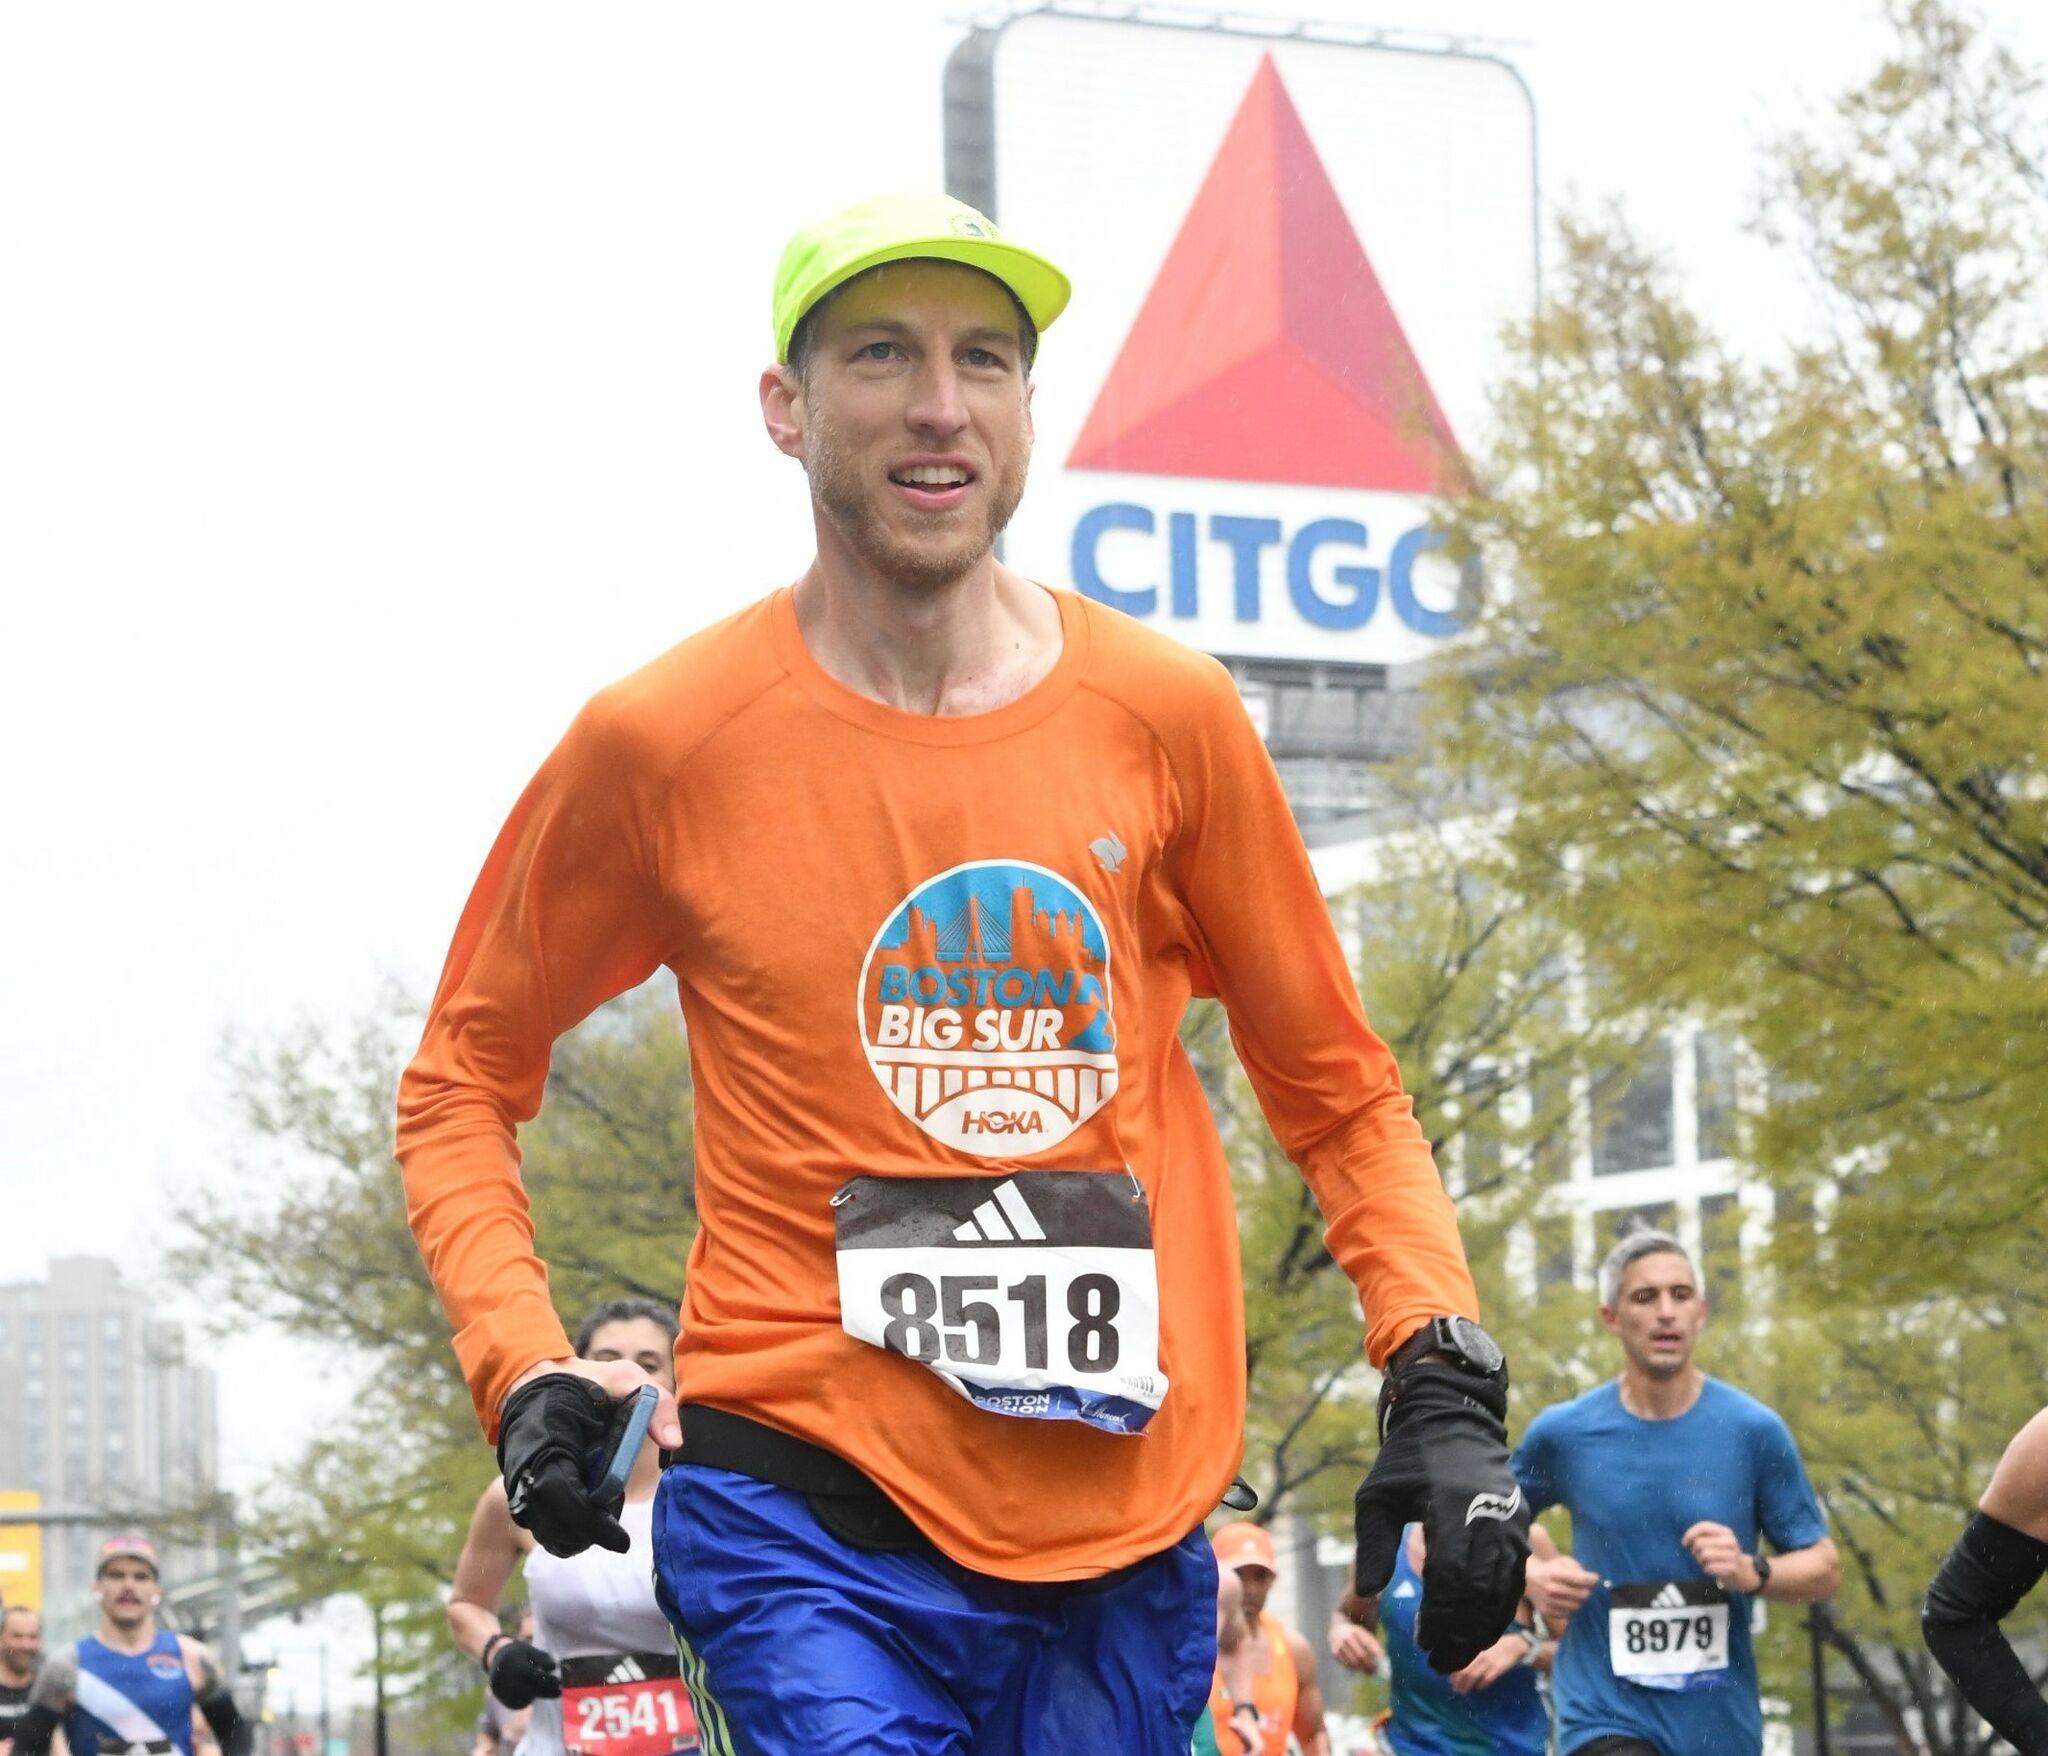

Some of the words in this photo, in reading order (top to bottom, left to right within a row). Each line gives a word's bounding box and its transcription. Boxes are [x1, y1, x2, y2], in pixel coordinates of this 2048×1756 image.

[1070, 503, 1482, 637] CITGO
[879, 964, 1076, 1008] BOSTON
[877, 1005, 963, 1050] BIG
[971, 1008, 1064, 1052] SUR
[961, 1110, 1043, 1135] HOKA
[880, 1272, 1121, 1374] 8518
[1626, 1616, 1713, 1653] 8979
[577, 1689, 679, 1740] 2541
